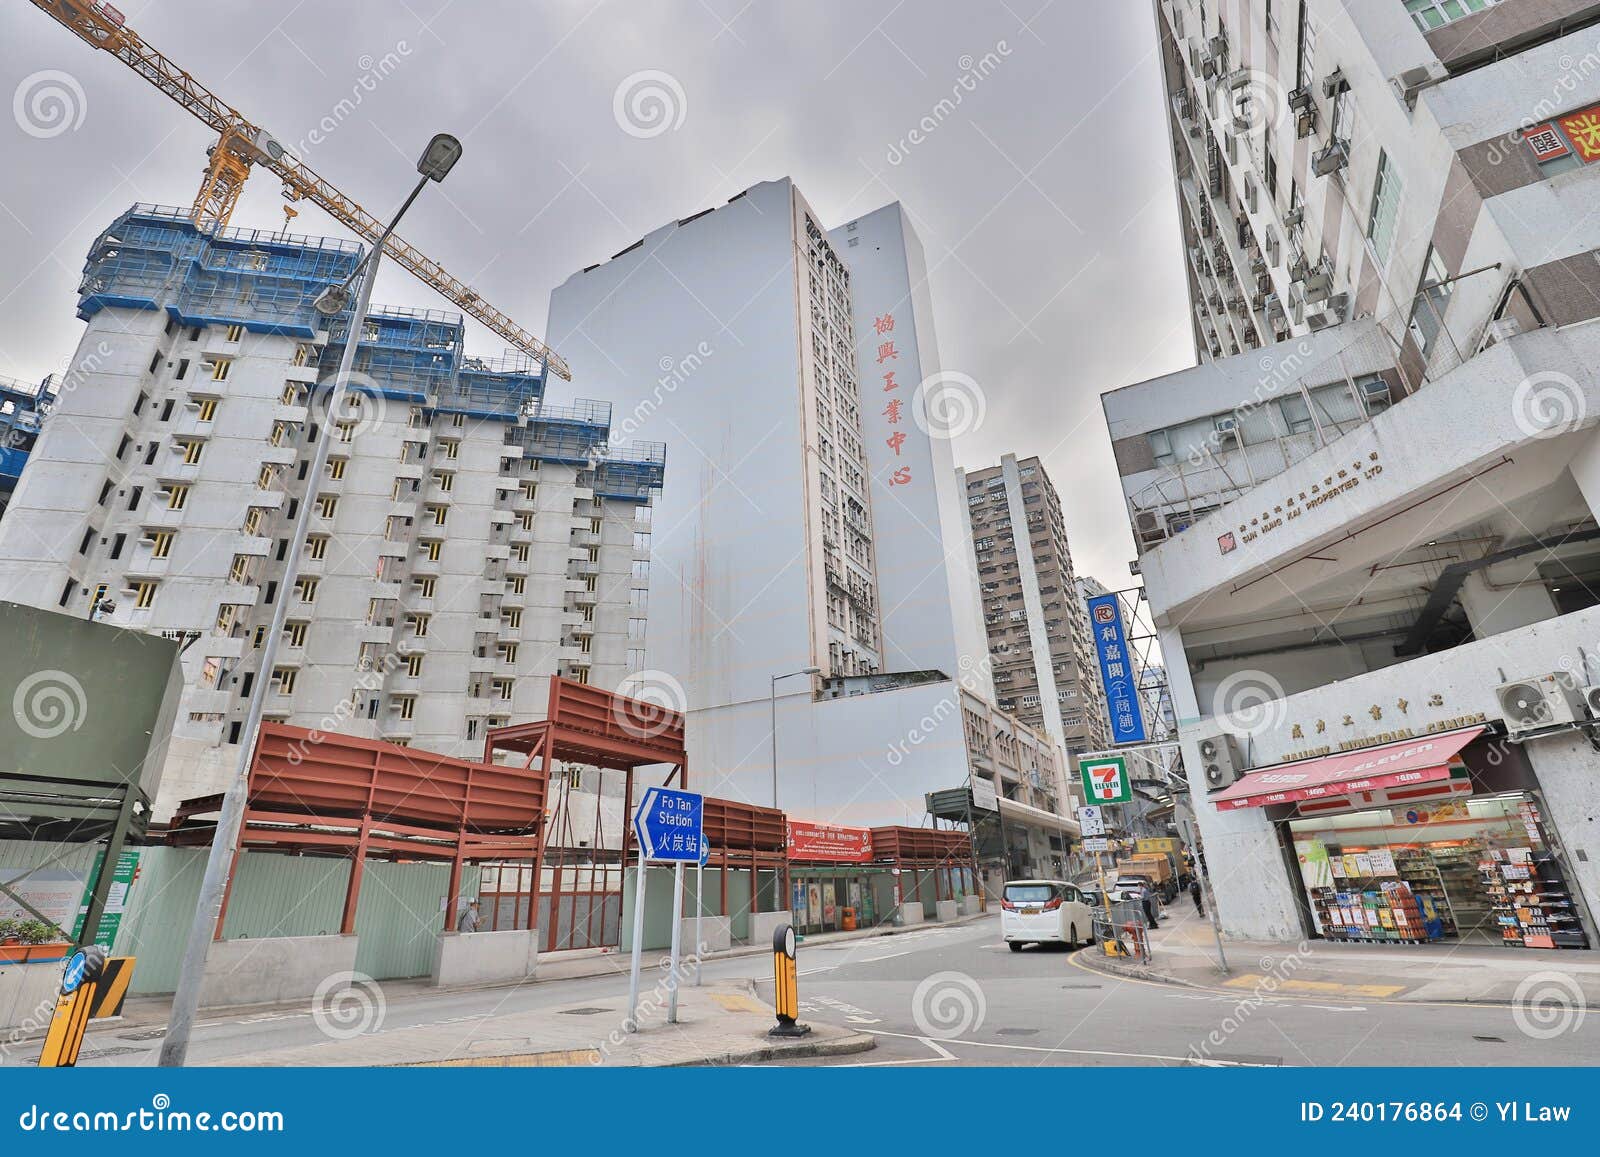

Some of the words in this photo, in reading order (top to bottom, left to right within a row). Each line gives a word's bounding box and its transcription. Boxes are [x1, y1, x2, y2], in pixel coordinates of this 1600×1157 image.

[662, 796, 674, 809] Fo
[676, 797, 692, 811] Tan
[659, 811, 692, 827] Station
[659, 832, 697, 852] 火炭站
